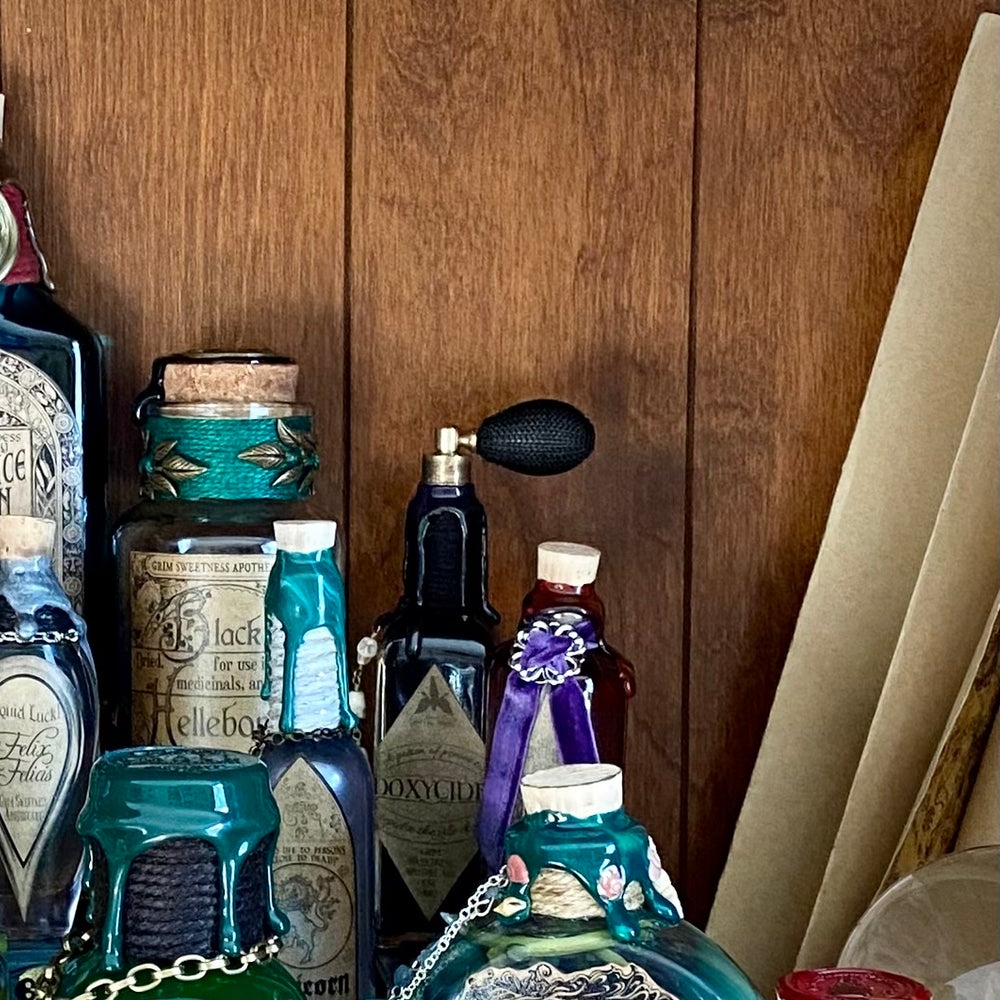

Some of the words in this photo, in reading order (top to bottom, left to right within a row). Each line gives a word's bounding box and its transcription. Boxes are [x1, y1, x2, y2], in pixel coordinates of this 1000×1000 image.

[151, 561, 173, 572] GRIM
[176, 561, 230, 573] SWEETNESS
[213, 656, 232, 672] for
[237, 660, 257, 672] use
[176, 675, 245, 692] medicinals,
[153, 664, 256, 747] Hellebo
[298, 972, 350, 996] corn
